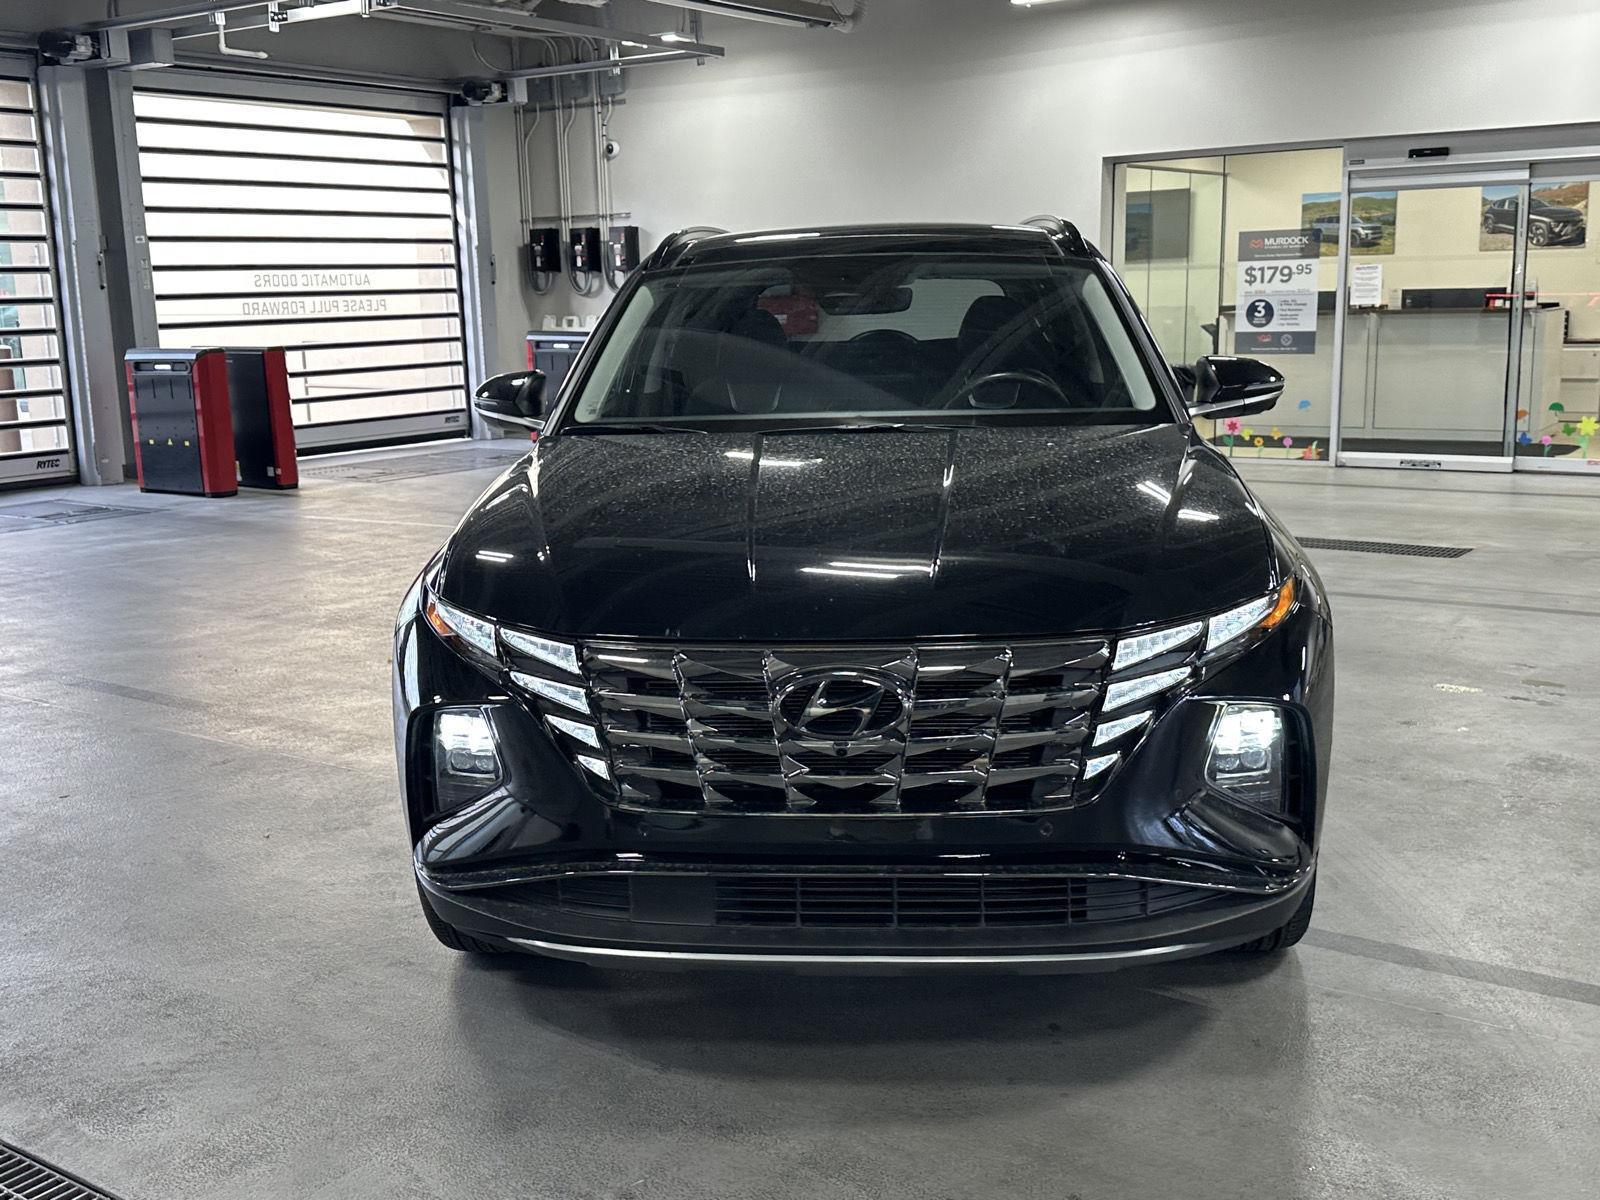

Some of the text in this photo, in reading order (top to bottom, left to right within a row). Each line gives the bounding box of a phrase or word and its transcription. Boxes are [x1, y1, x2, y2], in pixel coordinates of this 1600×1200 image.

[1264, 236, 1309, 246] MURDOCK
[1254, 301, 1266, 317] 3
[36, 459, 60, 470] RYTEC
